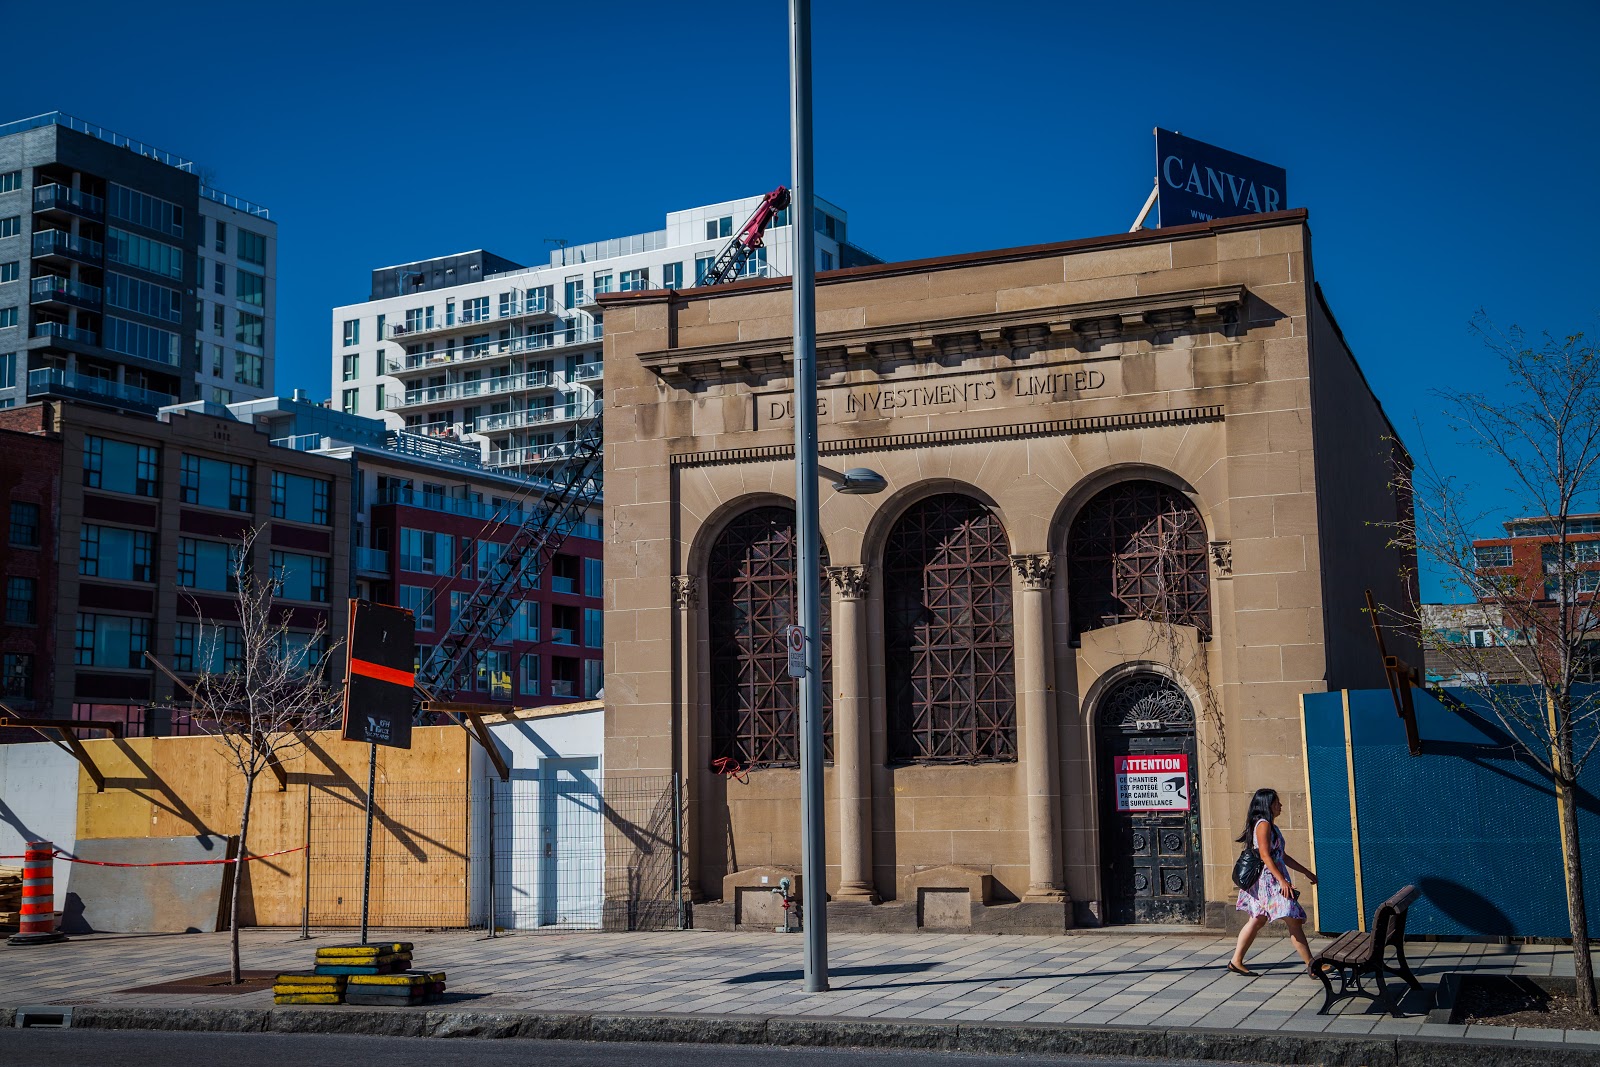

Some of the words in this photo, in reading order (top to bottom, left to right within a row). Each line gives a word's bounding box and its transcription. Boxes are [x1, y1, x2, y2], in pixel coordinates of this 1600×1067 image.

[1163, 155, 1280, 213] CANVAR
[769, 397, 827, 420] DUE
[845, 380, 996, 413] INVESTMENTS
[1015, 370, 1105, 397] LIMITED
[1140, 722, 1158, 730] 297
[1121, 759, 1180, 771] ATTENTION
[1133, 791, 1159, 799] CAMÉRA
[1129, 799, 1173, 807] SURVEILLANCE
